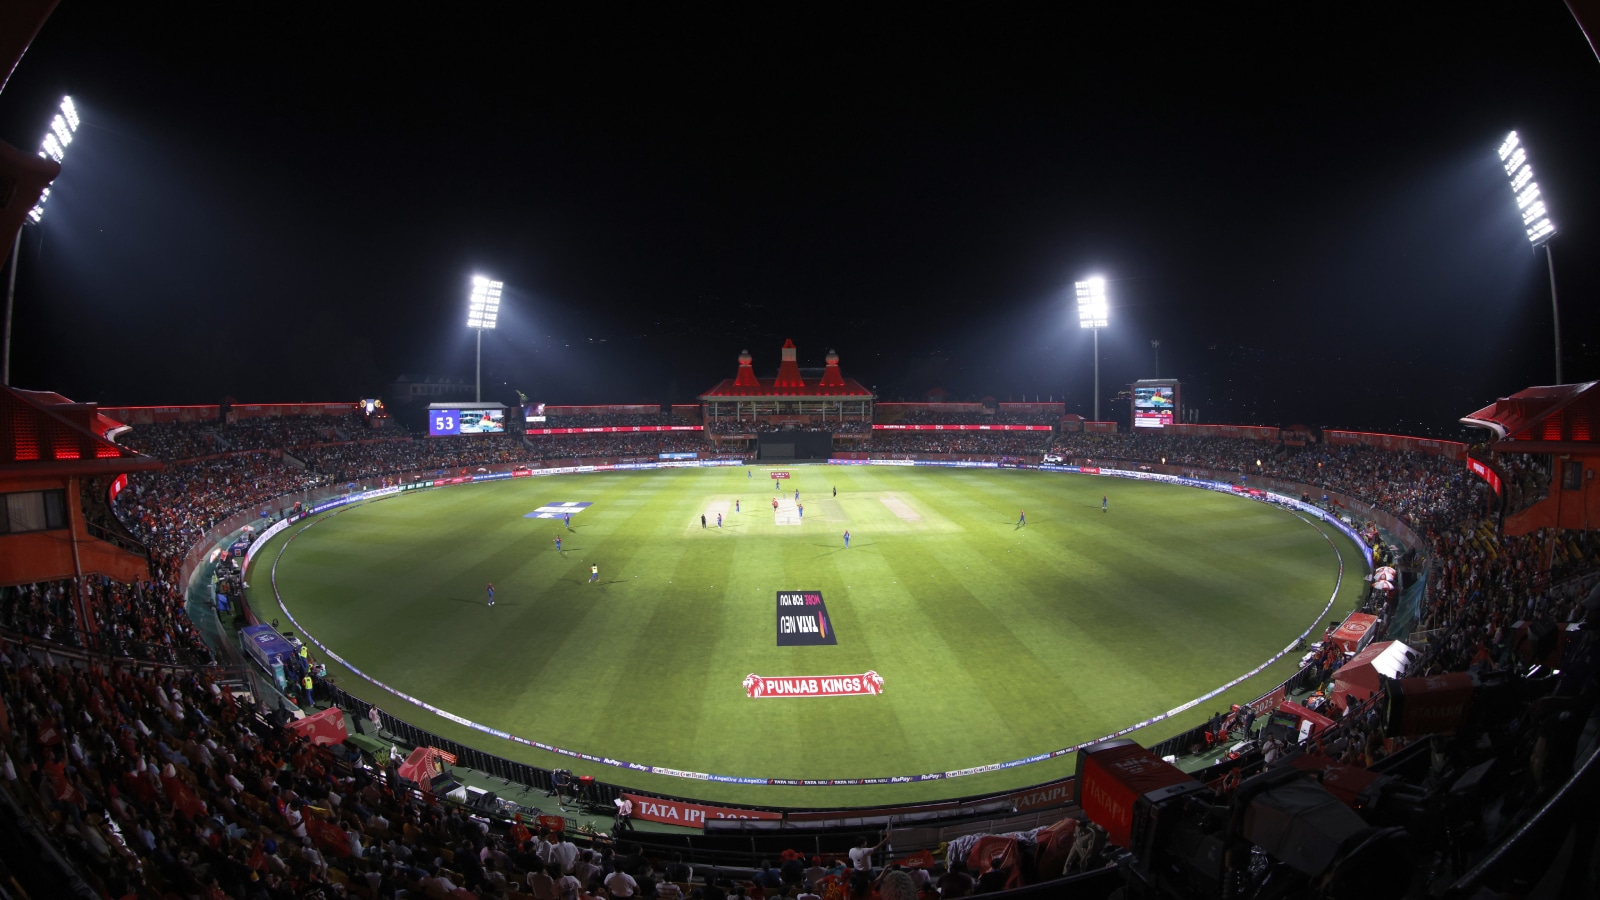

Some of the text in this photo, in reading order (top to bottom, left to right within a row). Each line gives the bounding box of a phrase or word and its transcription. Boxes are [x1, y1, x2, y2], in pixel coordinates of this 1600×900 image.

[436, 417, 454, 430] 53
[780, 594, 821, 606] MORE FOR YOU
[780, 615, 819, 634] TATA NEU
[766, 678, 862, 694] PUNJAB KINGS
[603, 757, 620, 766] RuPay
[629, 762, 646, 771] RuPay
[714, 775, 737, 783] AngelOne
[639, 801, 679, 819] TATA
